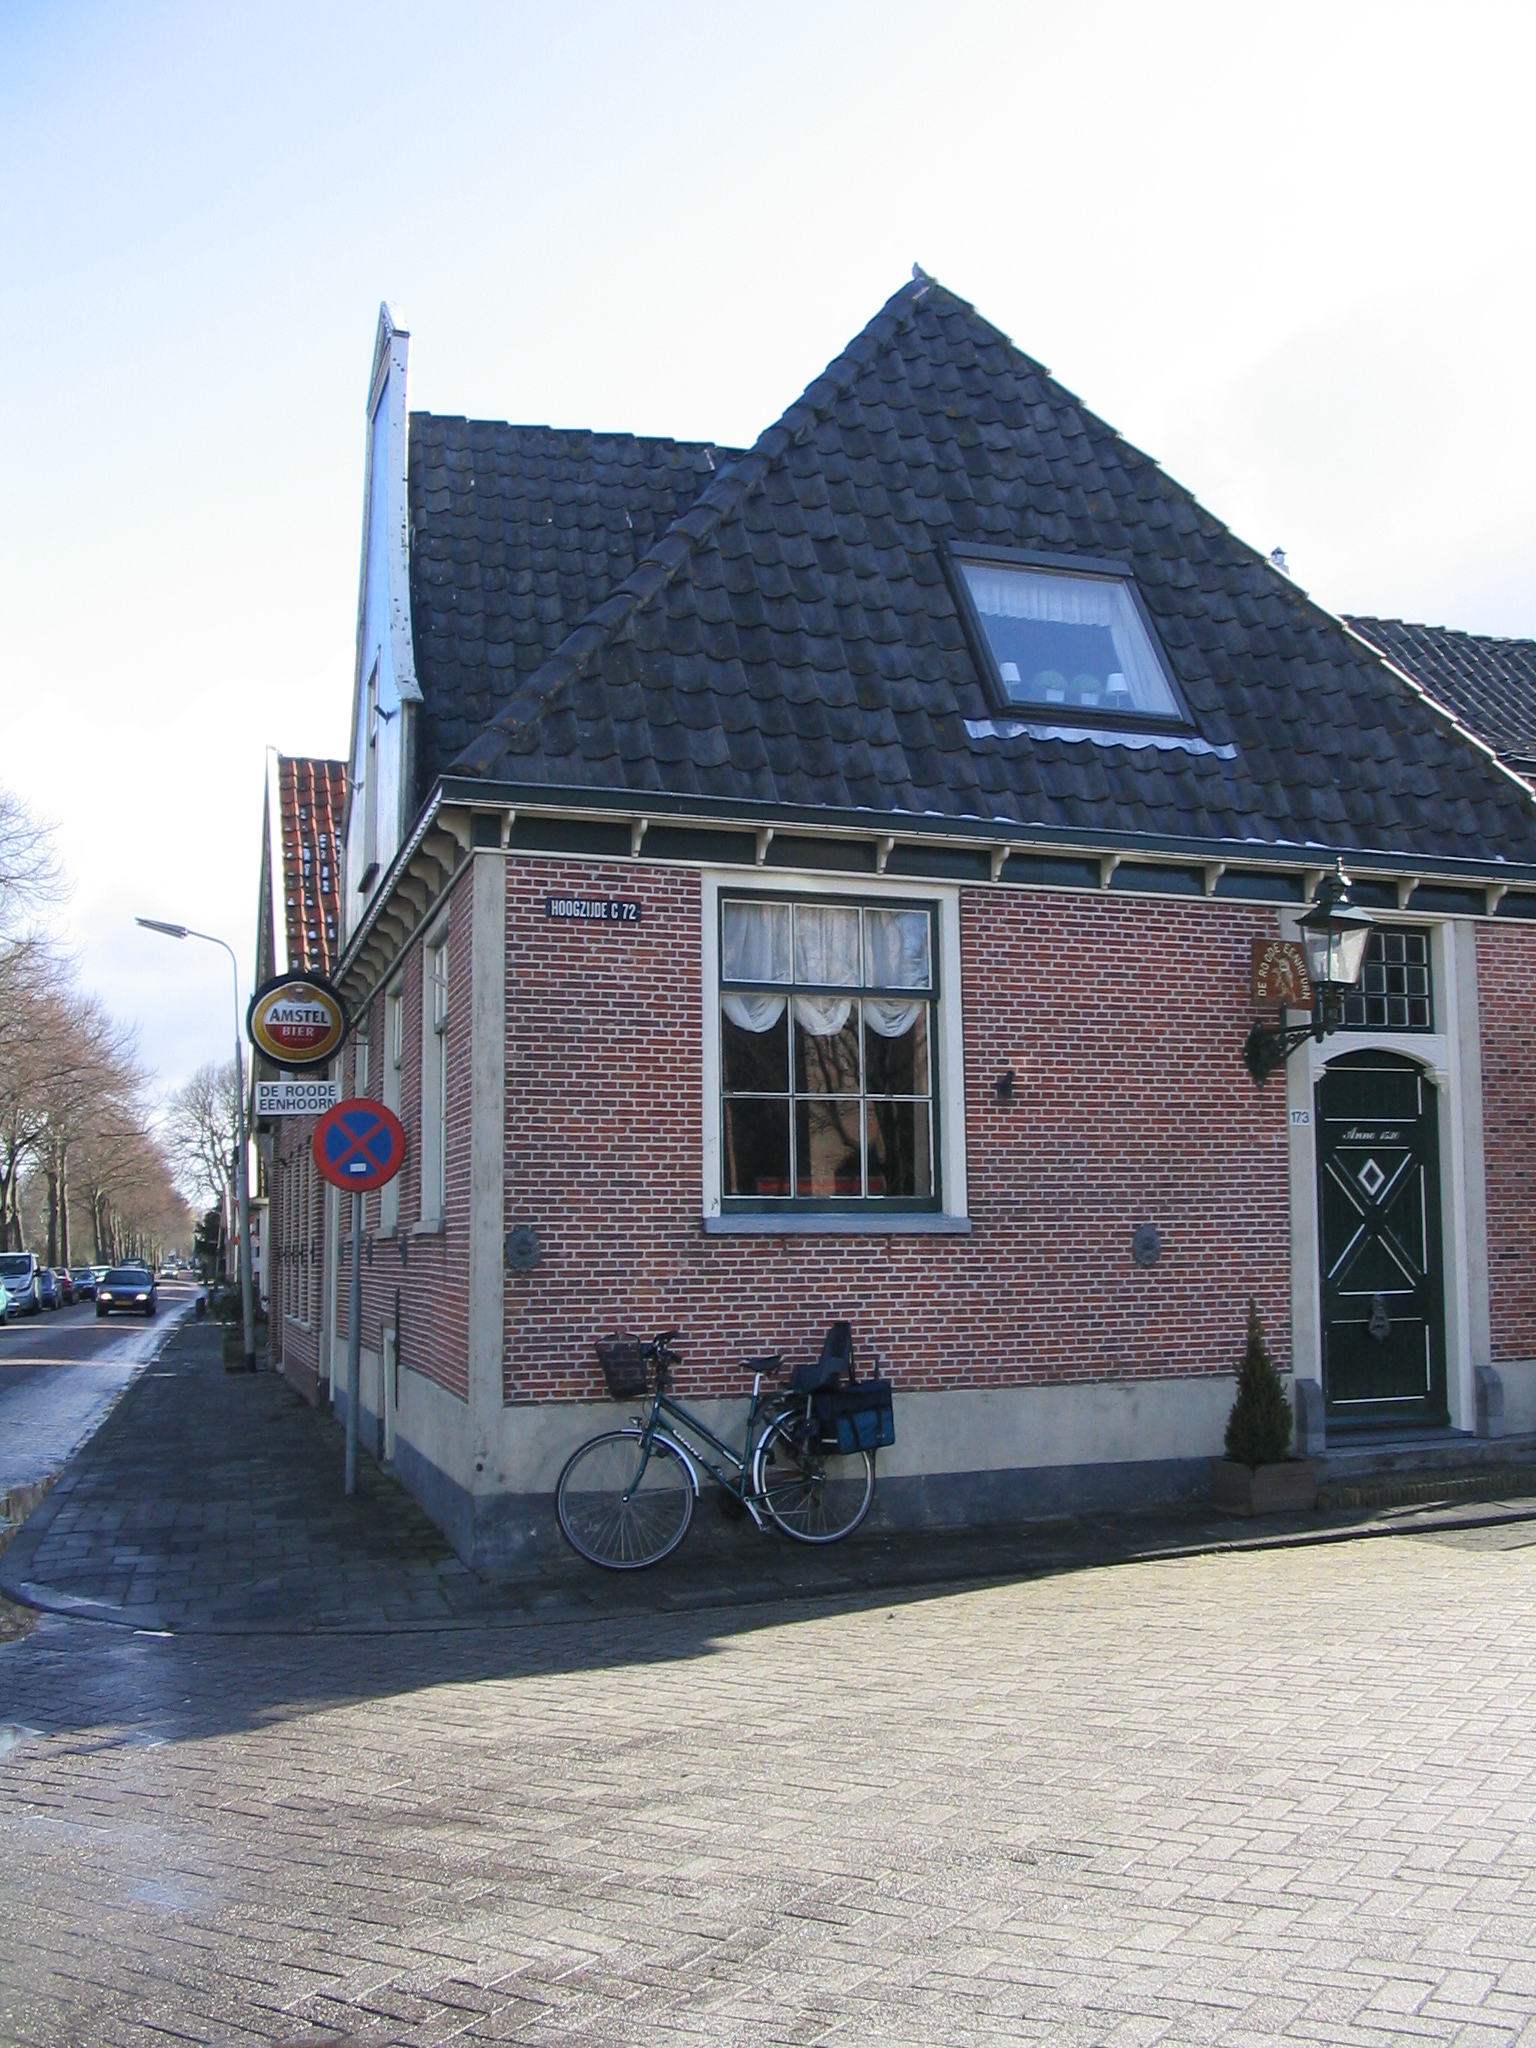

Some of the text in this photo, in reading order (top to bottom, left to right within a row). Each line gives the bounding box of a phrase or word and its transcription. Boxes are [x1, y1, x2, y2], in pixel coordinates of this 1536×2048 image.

[551, 900, 636, 919] HOOGZIJDE C 72
[1258, 942, 1281, 978] ROODE
[1258, 981, 1267, 997] DE
[270, 1008, 328, 1024] AMSTEL
[282, 1025, 315, 1037] BIER
[260, 1085, 336, 1097] DE ROODE
[260, 1098, 337, 1110] EENHOORN
[1291, 1111, 1310, 1123] 173
